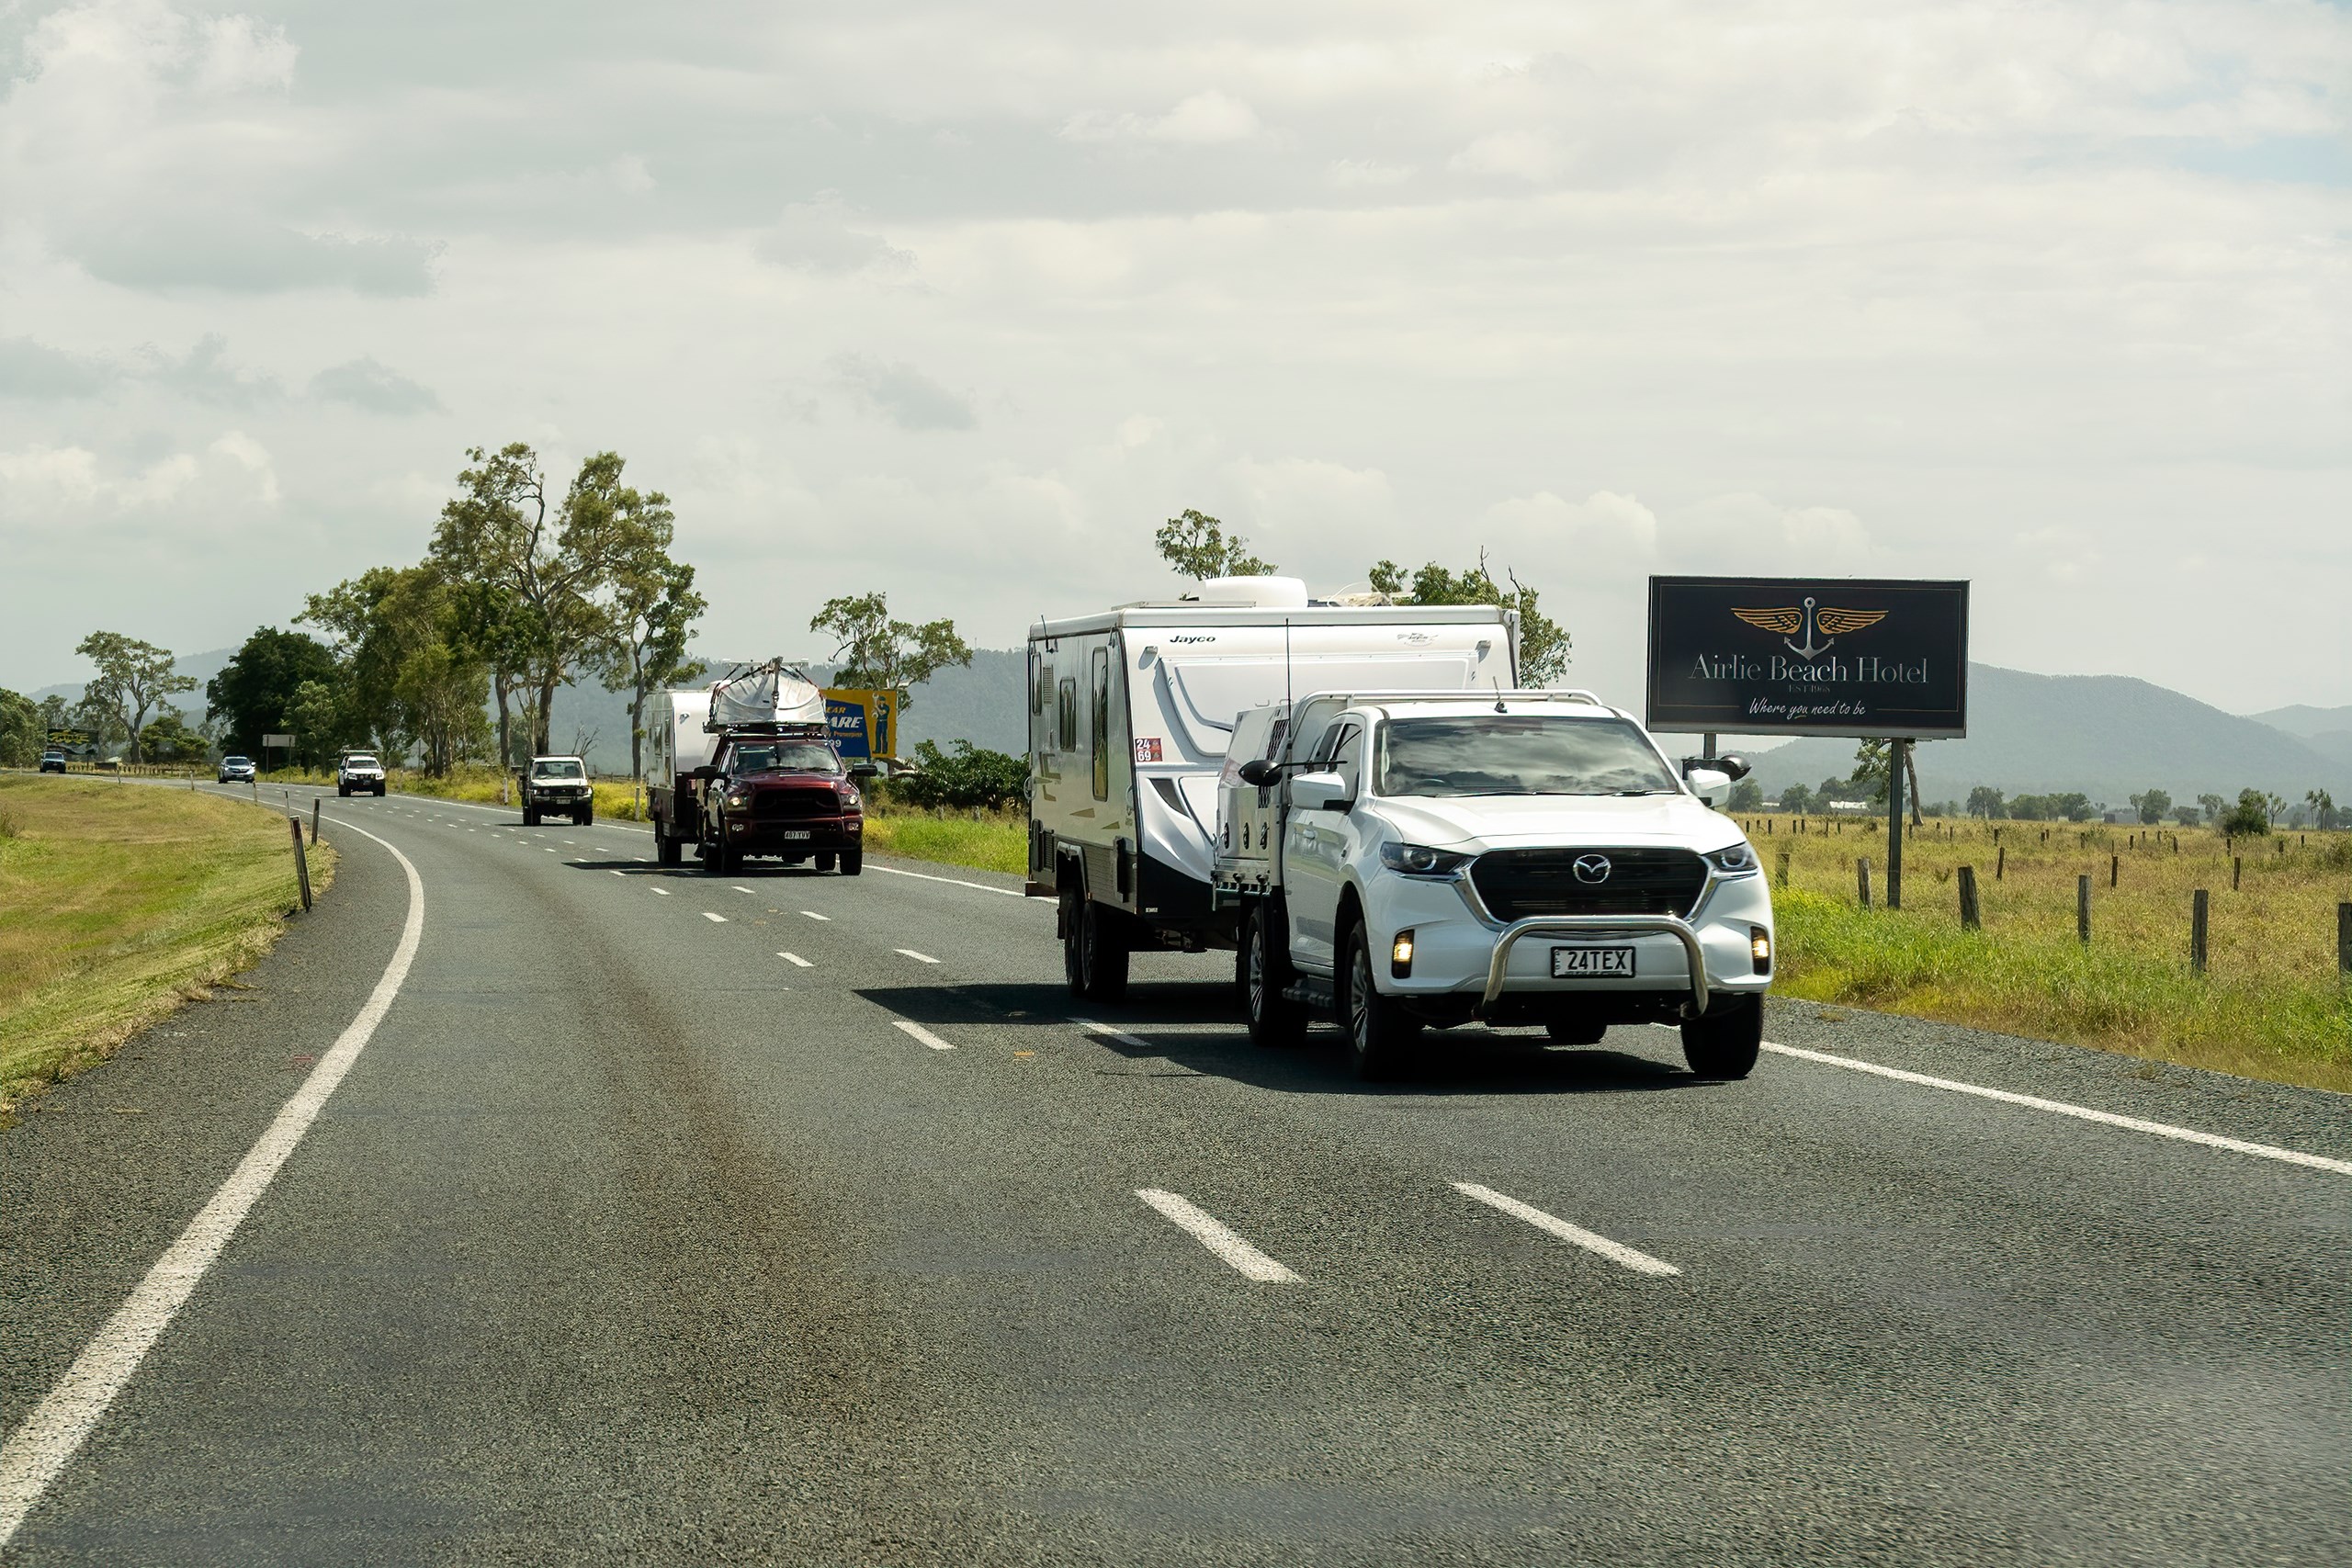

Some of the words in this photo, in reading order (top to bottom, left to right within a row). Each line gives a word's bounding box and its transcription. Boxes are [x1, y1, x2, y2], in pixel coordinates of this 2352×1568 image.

[1170, 635, 1216, 644] Jayco
[1688, 653, 1761, 681] Airlie
[1768, 655, 1848, 682] Beach
[1855, 656, 1928, 683] Hotel
[1748, 697, 1787, 714] Where
[1786, 705, 1808, 720] you
[1811, 700, 1839, 715] need
[1839, 702, 1851, 715] to
[1853, 700, 1866, 715] be
[829, 716, 864, 728] ARE
[1136, 739, 1151, 750] 24
[1137, 750, 1152, 761] 69
[1567, 951, 1627, 971] 24TEX
